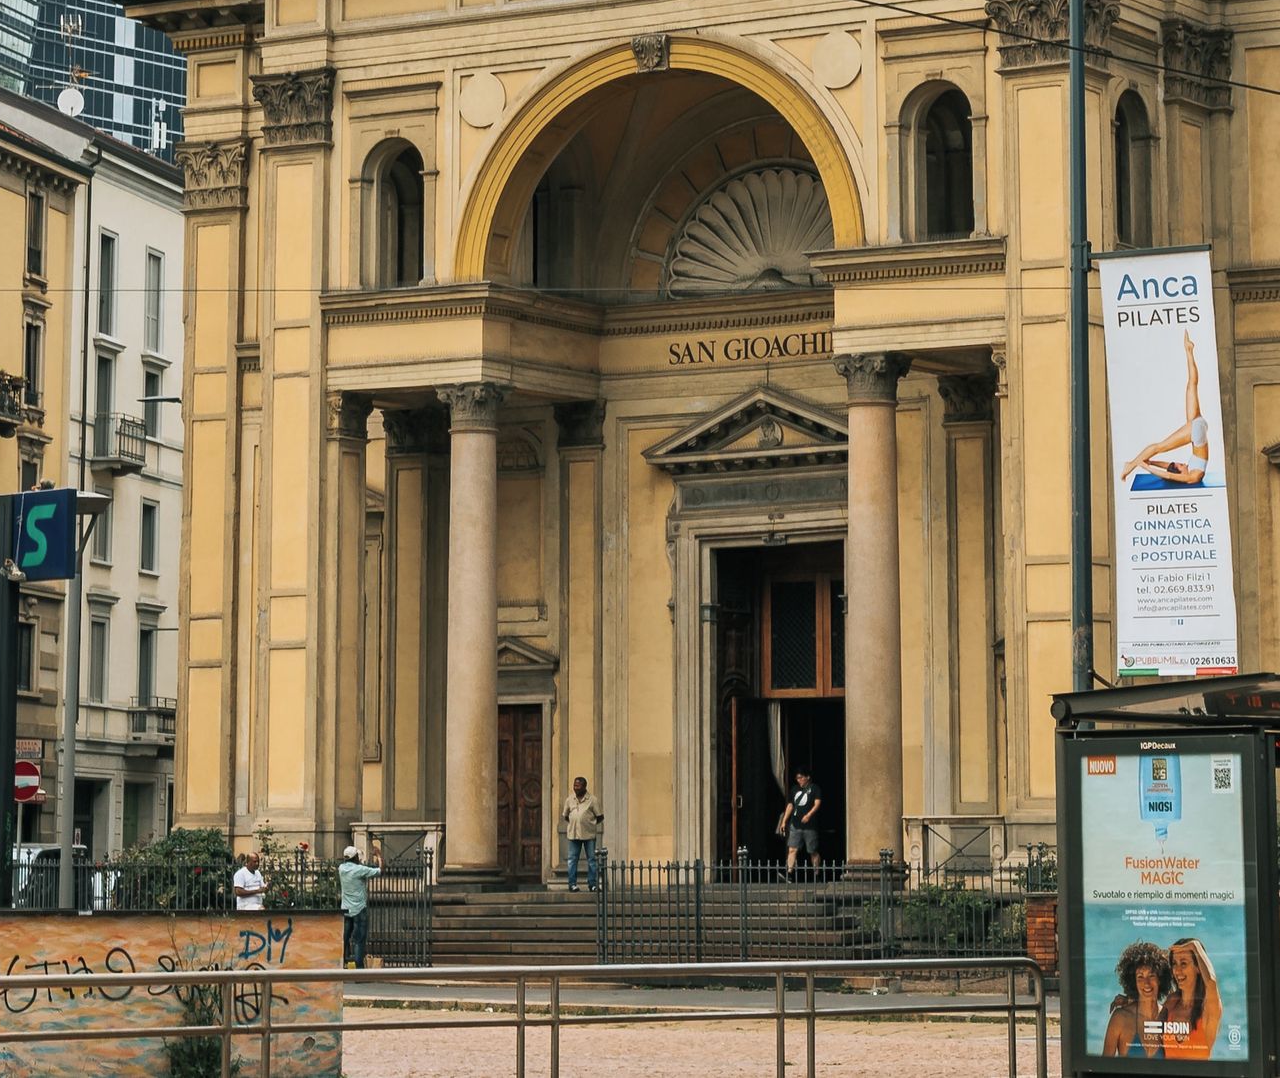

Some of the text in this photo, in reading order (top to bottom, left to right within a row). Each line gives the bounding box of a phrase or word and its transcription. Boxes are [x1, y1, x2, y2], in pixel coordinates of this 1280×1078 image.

[1117, 273, 1198, 301] Anca
[1117, 306, 1200, 327] PILATES
[669, 340, 716, 365] SAN
[1147, 503, 1198, 515] PILATES
[1134, 518, 1212, 531] GINNASTICA
[22, 504, 57, 567] S
[1132, 534, 1215, 547] FUNZIONALE
[1131, 549, 1217, 562] e POSTURALE
[1140, 574, 1155, 583] Via
[1158, 573, 1184, 582] Fabio
[1186, 573, 1205, 582] Filzi
[1137, 584, 1215, 594] tel. 02.669.833.91
[1137, 596, 1213, 604] www.ancapilates.com
[1137, 604, 1214, 612] info@ancapilates.com
[1140, 742, 1176, 750] IGPDecaux
[1089, 761, 1115, 774] NUOVO
[1148, 802, 1172, 812] ISDIN
[1125, 856, 1200, 869] FusionWater
[1093, 890, 1126, 899] Svuotalo
[1134, 890, 1163, 900] riempilo
[1165, 890, 1173, 899] di
[1174, 890, 1208, 899] momenti
[1210, 890, 1235, 901] magici
[1164, 1021, 1190, 1034] ISDIN
